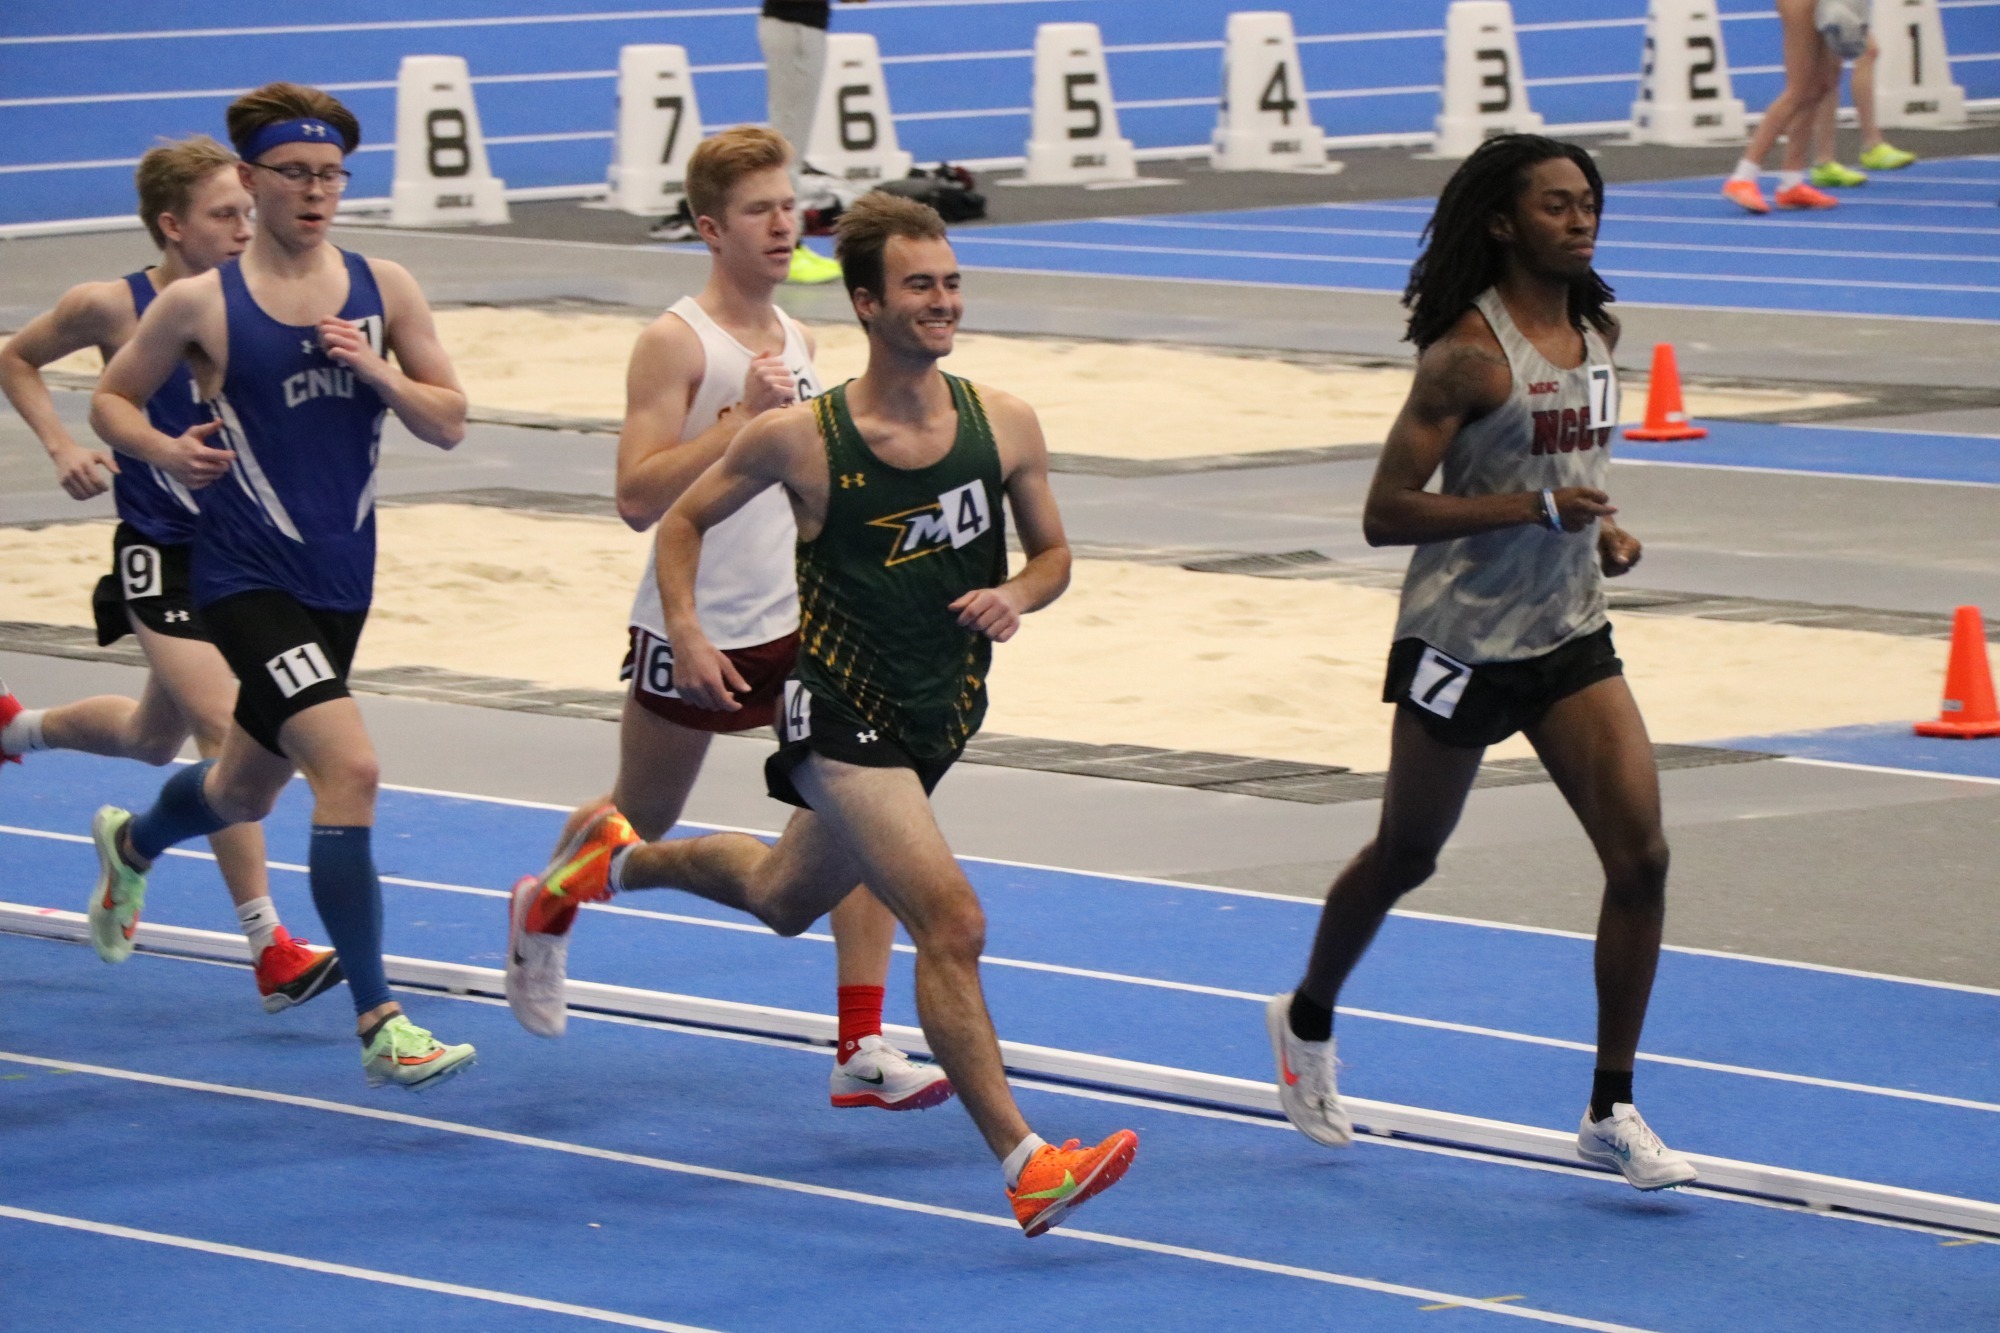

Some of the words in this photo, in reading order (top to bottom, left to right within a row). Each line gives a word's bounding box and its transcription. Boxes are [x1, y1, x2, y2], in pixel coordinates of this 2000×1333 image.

[1475, 49, 1510, 113] 3
[1686, 36, 1718, 99] 2
[1907, 23, 1921, 86] 1
[837, 85, 877, 150] 6
[1063, 73, 1101, 138] 5
[1258, 61, 1297, 126] 4
[426, 108, 470, 177] 8
[654, 97, 684, 164] 7
[282, 367, 354, 408] CNU
[1592, 369, 1608, 422] 7
[957, 488, 983, 534] 4
[127, 548, 153, 594] 9
[274, 647, 322, 689] 11
[649, 645, 674, 693] 6
[1421, 654, 1465, 706] 7
[790, 684, 804, 737] 4
